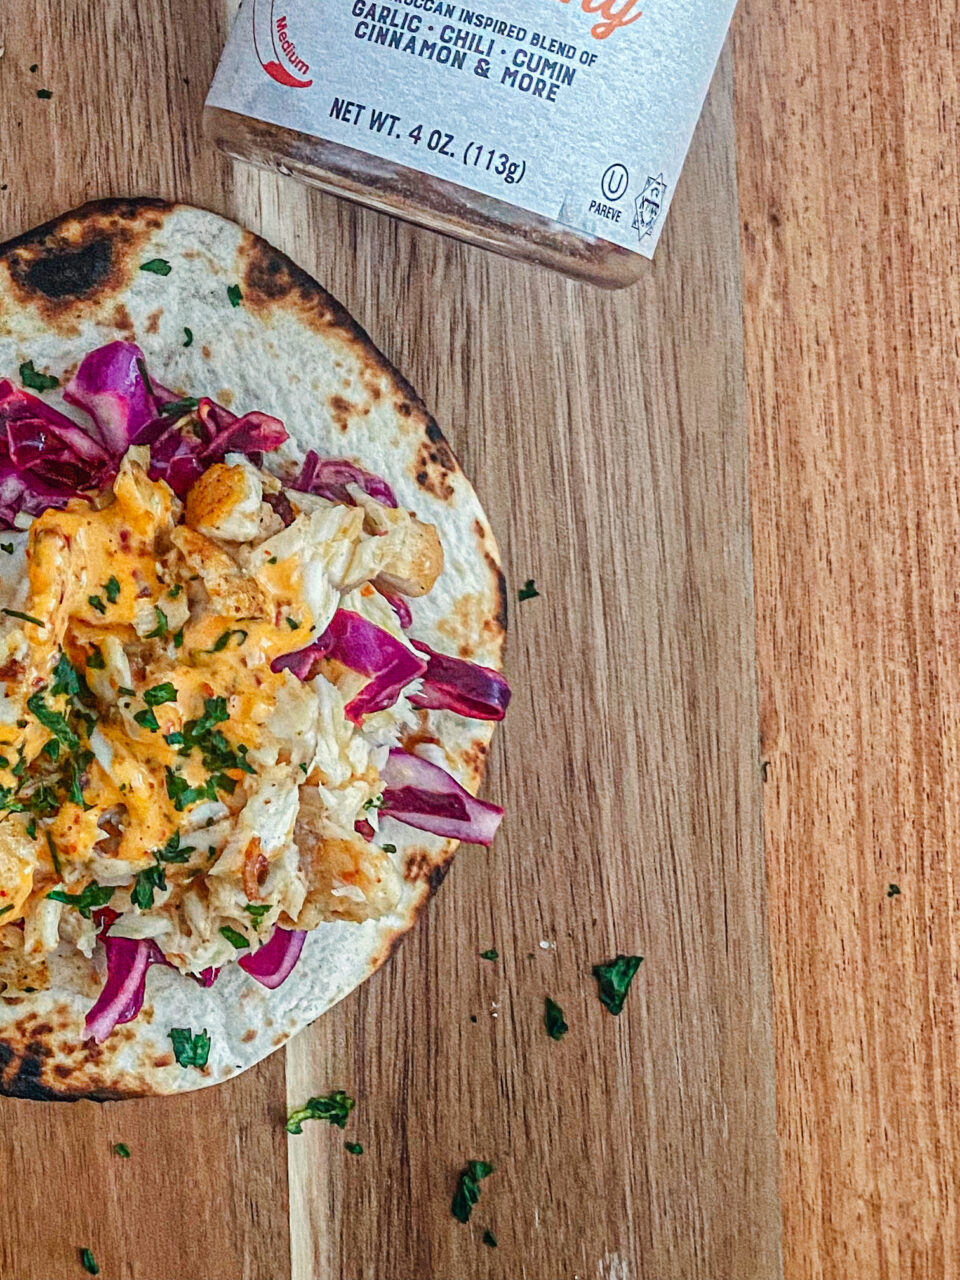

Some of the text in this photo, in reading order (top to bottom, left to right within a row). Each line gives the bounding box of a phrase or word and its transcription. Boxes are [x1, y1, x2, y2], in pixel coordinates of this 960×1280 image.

[276, 15, 310, 76] Medium
[351, 0, 576, 87] GARLIC CHILI CUMIN
[354, 21, 561, 103] CINNAMON & MORE
[457, 7, 527, 41] INSPIRED
[530, 33, 576, 60] BLEND
[579, 51, 598, 67] OF
[329, 97, 527, 185] NET WT. 4 OZ. (113g)
[588, 200, 623, 223] PAREVE
